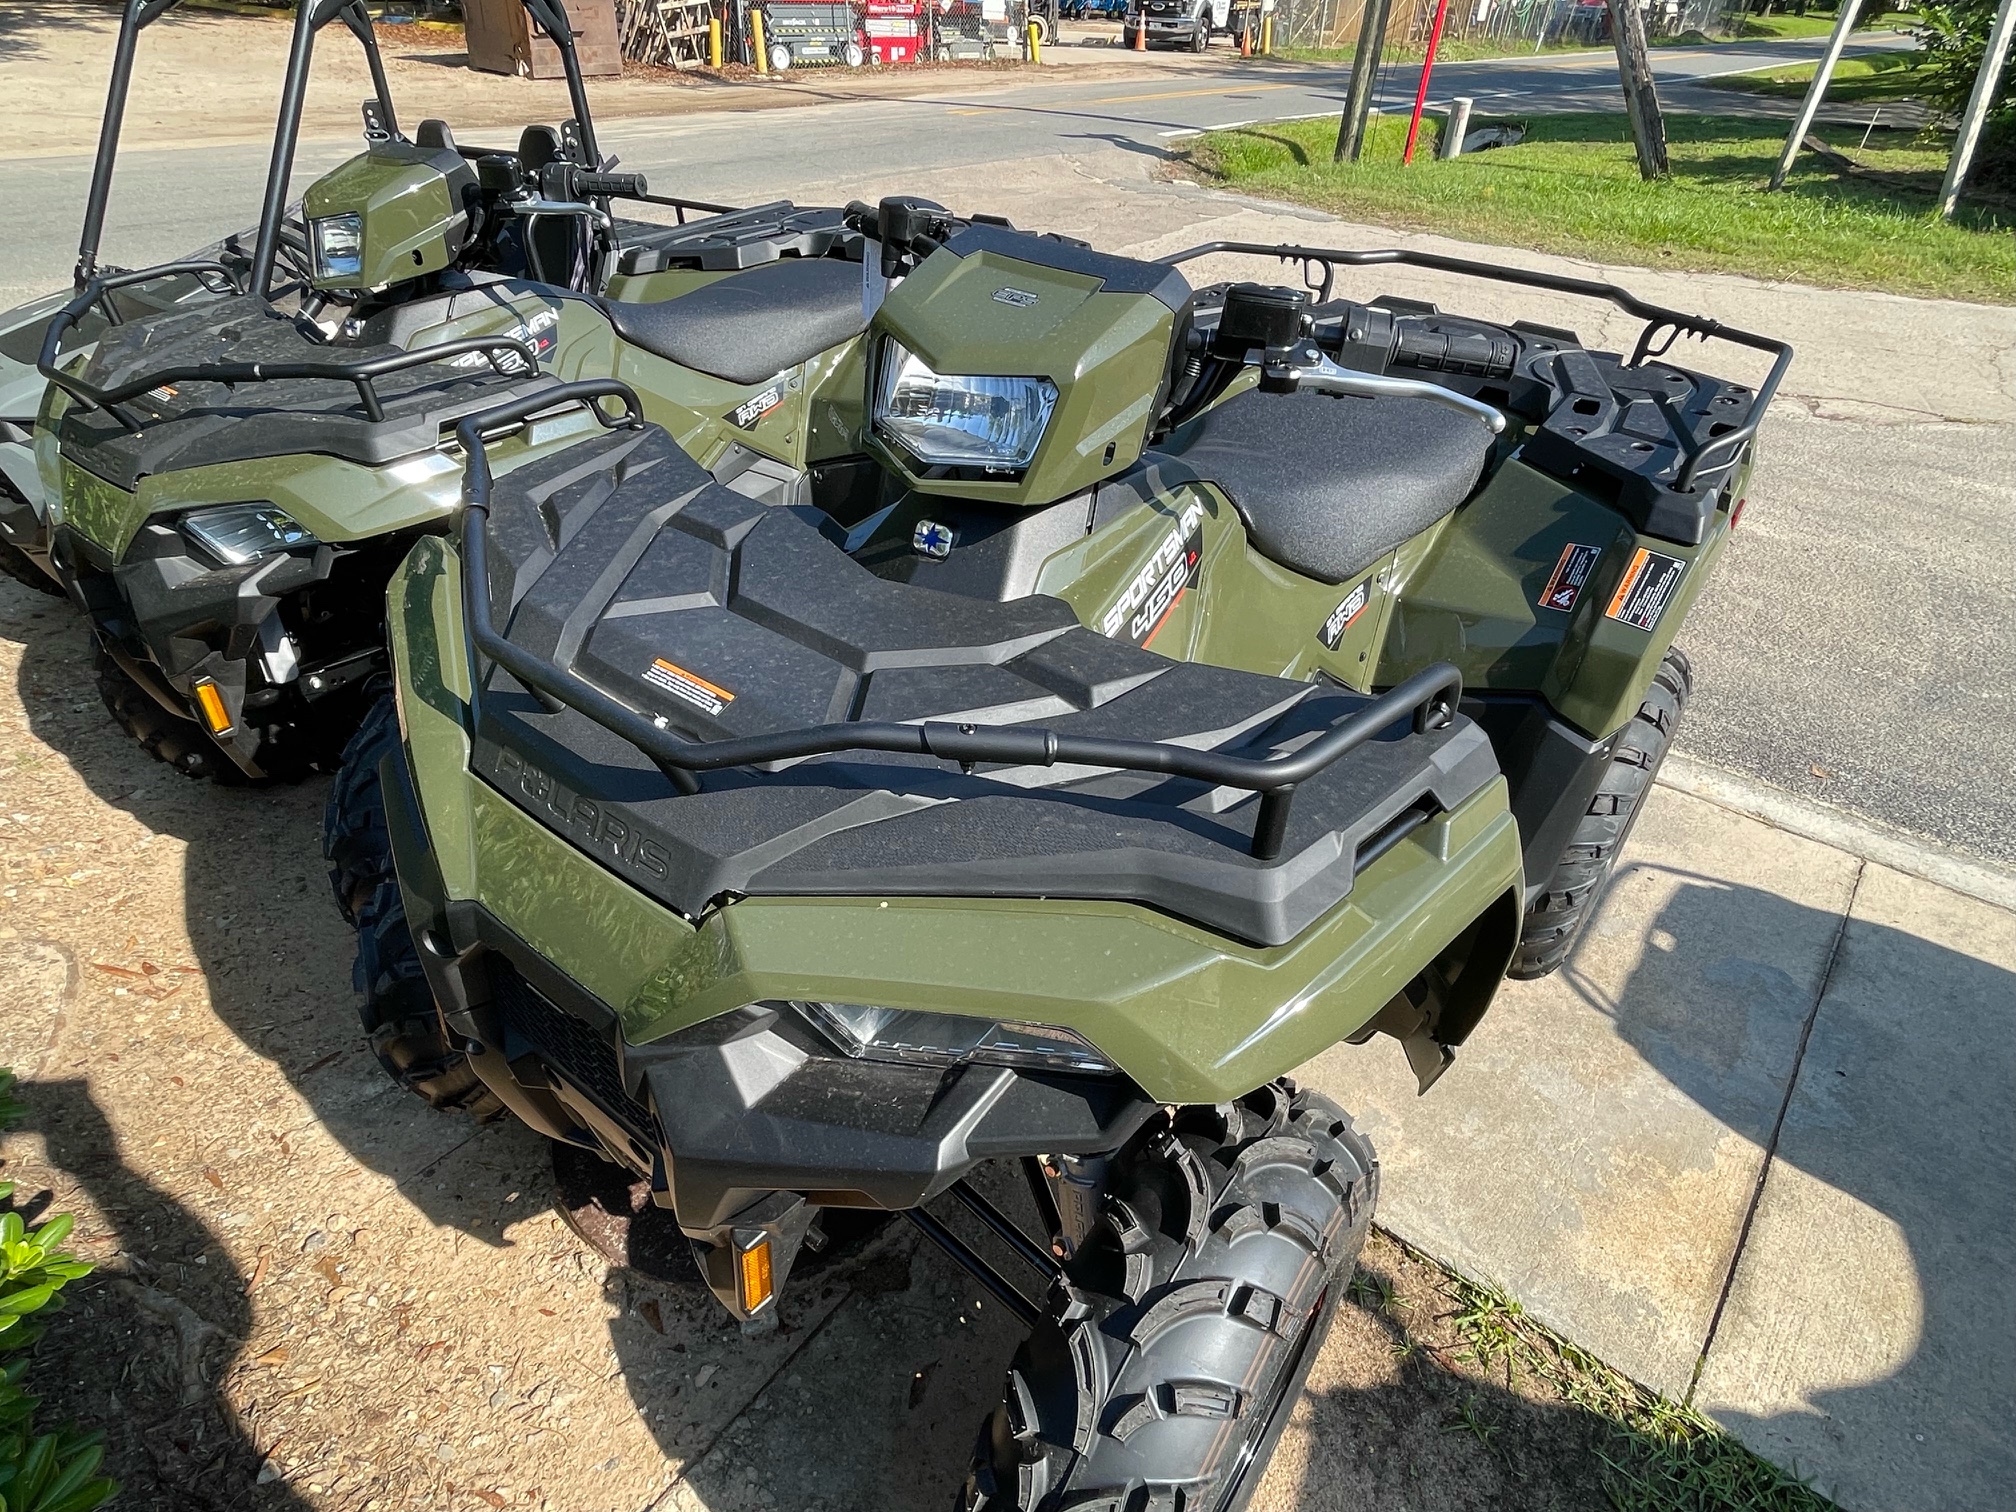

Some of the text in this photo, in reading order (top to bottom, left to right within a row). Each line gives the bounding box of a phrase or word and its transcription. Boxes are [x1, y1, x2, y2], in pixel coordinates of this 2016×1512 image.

[737, 392, 779, 426] AWD
[1103, 494, 1204, 638] SPORTSMAN
[1131, 551, 1189, 640] 450
[1620, 565, 1640, 596] WARNING
[1327, 591, 1365, 645] AWD
[494, 744, 672, 882] POLARIS
